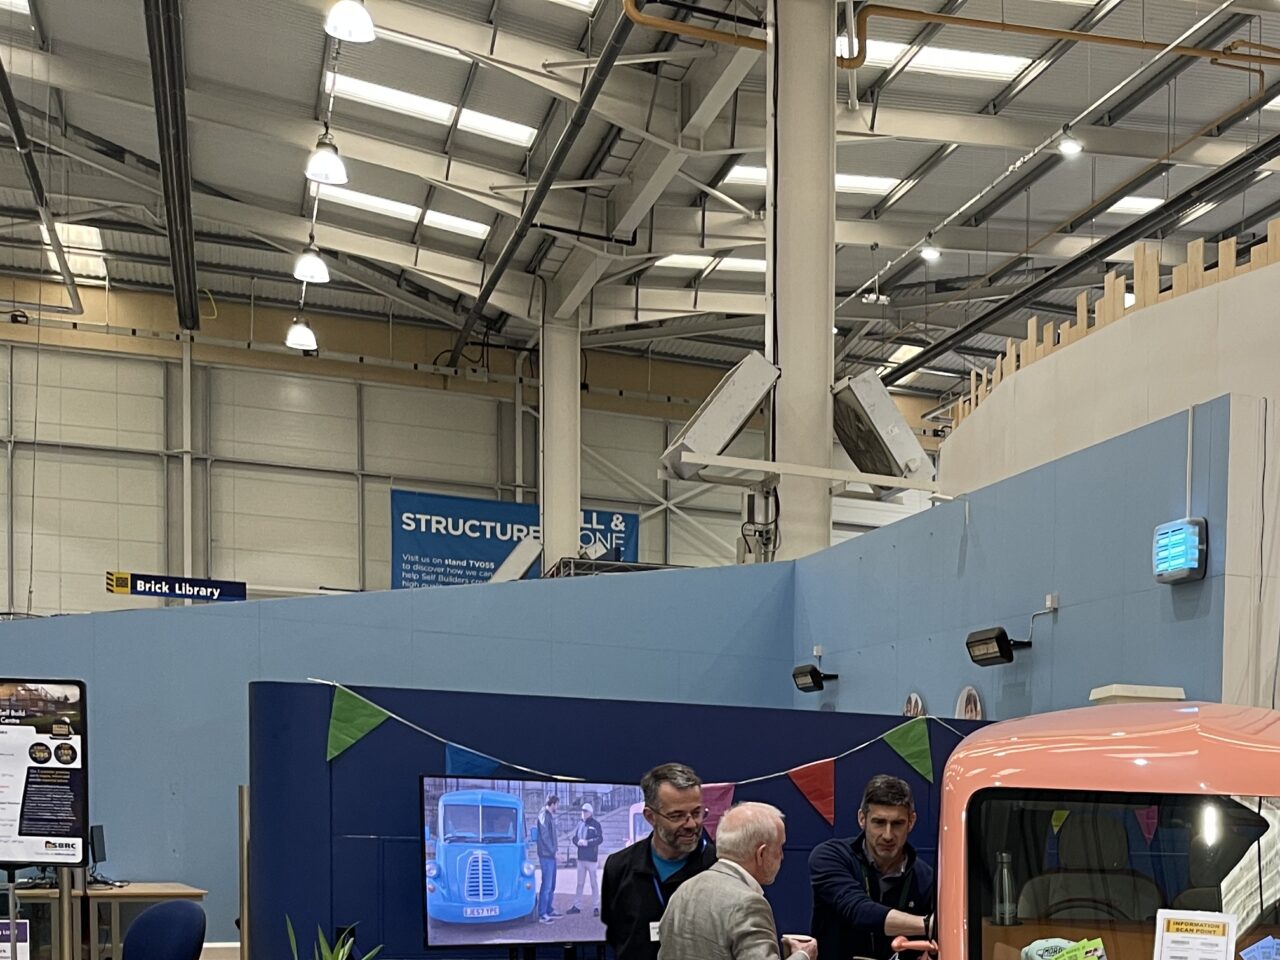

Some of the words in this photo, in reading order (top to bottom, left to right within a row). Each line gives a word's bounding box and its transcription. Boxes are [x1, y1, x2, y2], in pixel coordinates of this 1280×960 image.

[402, 553, 419, 562] Visit
[445, 558, 467, 567] stand
[402, 562, 411, 570] to
[412, 563, 444, 573] discover
[446, 567, 463, 575] how
[402, 571, 419, 580] help
[421, 573, 436, 581] Self
[438, 574, 469, 584] Builders
[136, 580, 169, 593] Brick
[175, 582, 220, 599] Library
[1173, 921, 1220, 929] INFORMATION
